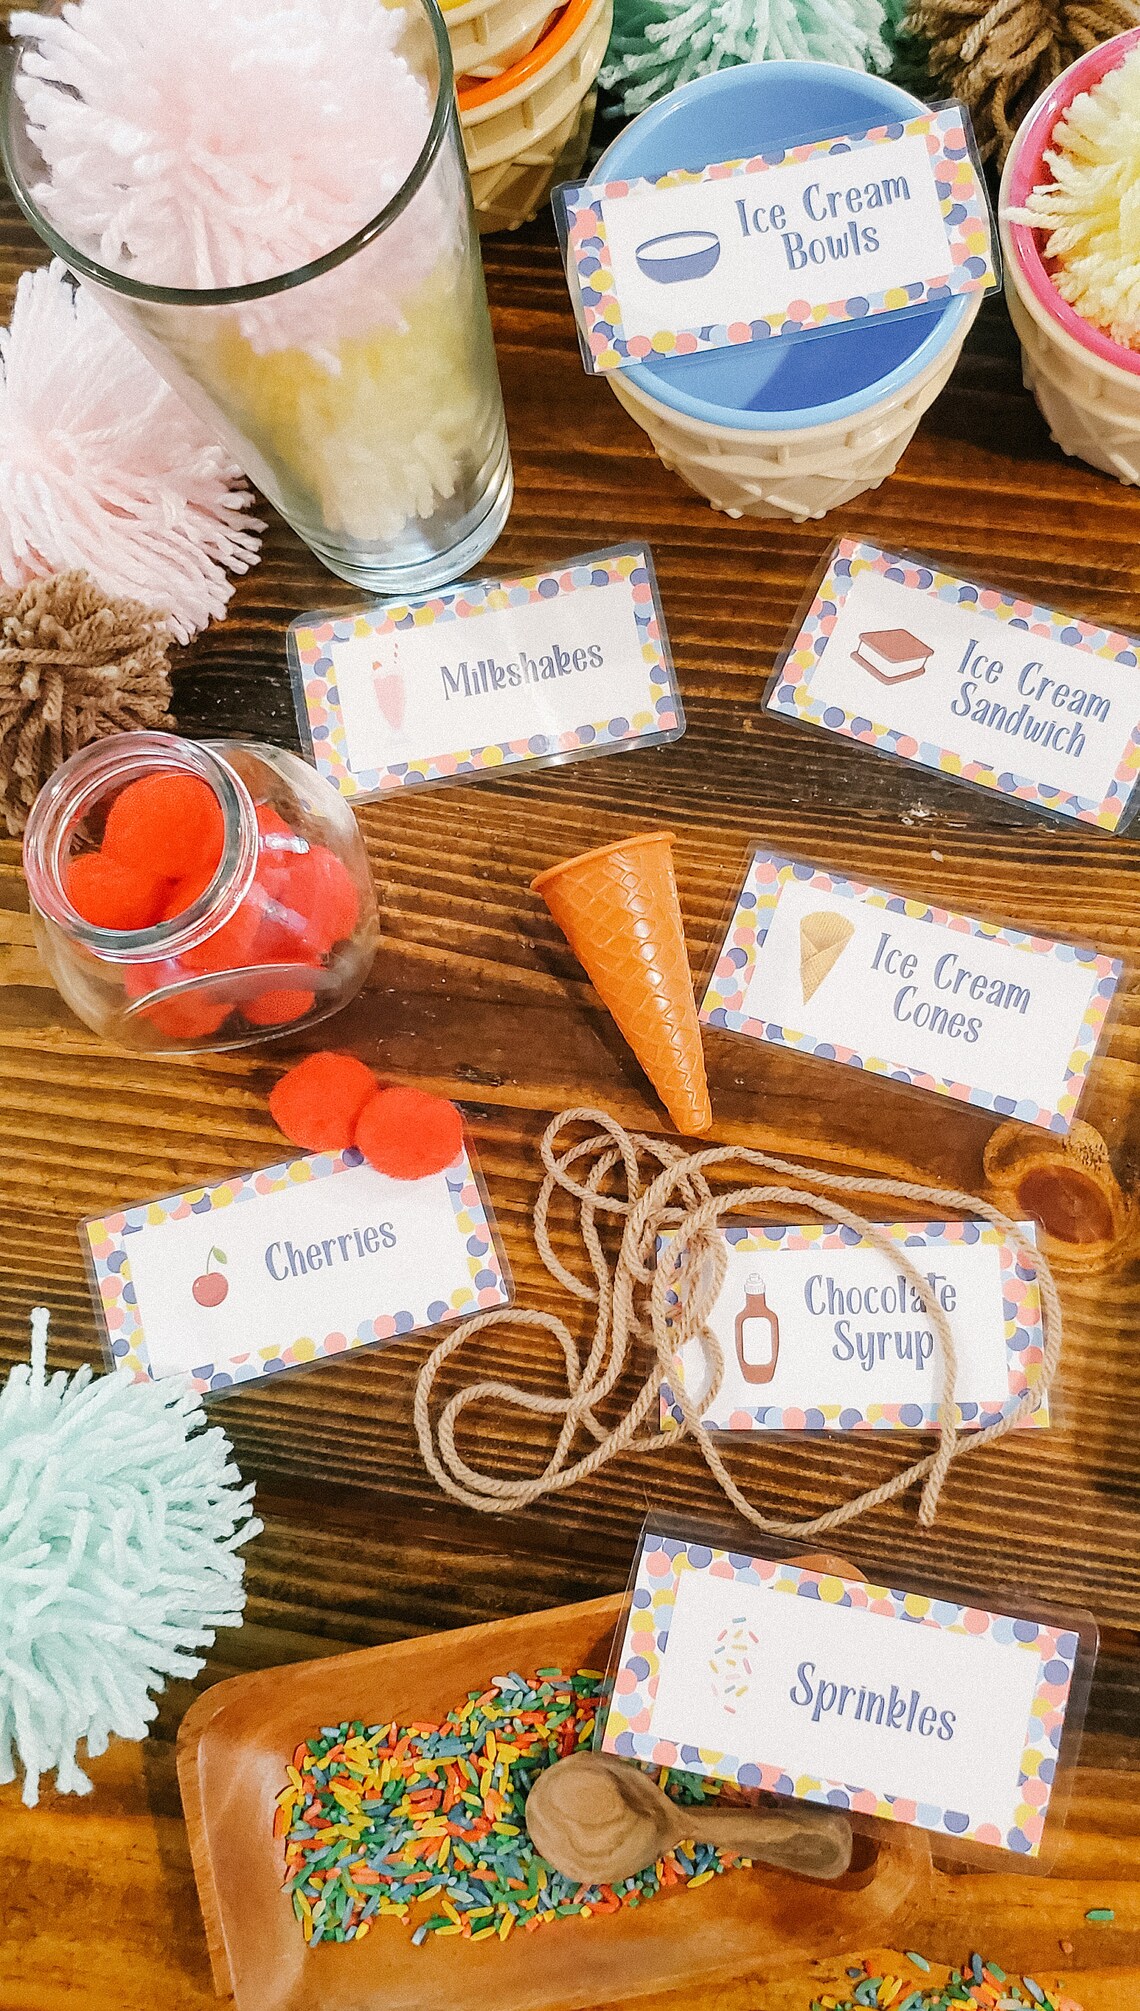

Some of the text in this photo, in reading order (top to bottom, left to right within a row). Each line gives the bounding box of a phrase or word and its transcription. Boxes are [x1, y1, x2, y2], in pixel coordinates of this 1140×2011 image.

[735, 174, 911, 239] Ice Cream
[781, 221, 880, 271] Bowls
[440, 642, 604, 701] Milkshakes
[956, 638, 1112, 723] Ice Cream
[950, 681, 1088, 758] Sandwich
[870, 932, 1032, 1014] Ice Cream
[892, 985, 983, 1043] Cones
[264, 1221, 397, 1281] Cherries
[832, 1320, 934, 1372] Syrup
[790, 1660, 957, 1742] Sprinkles
